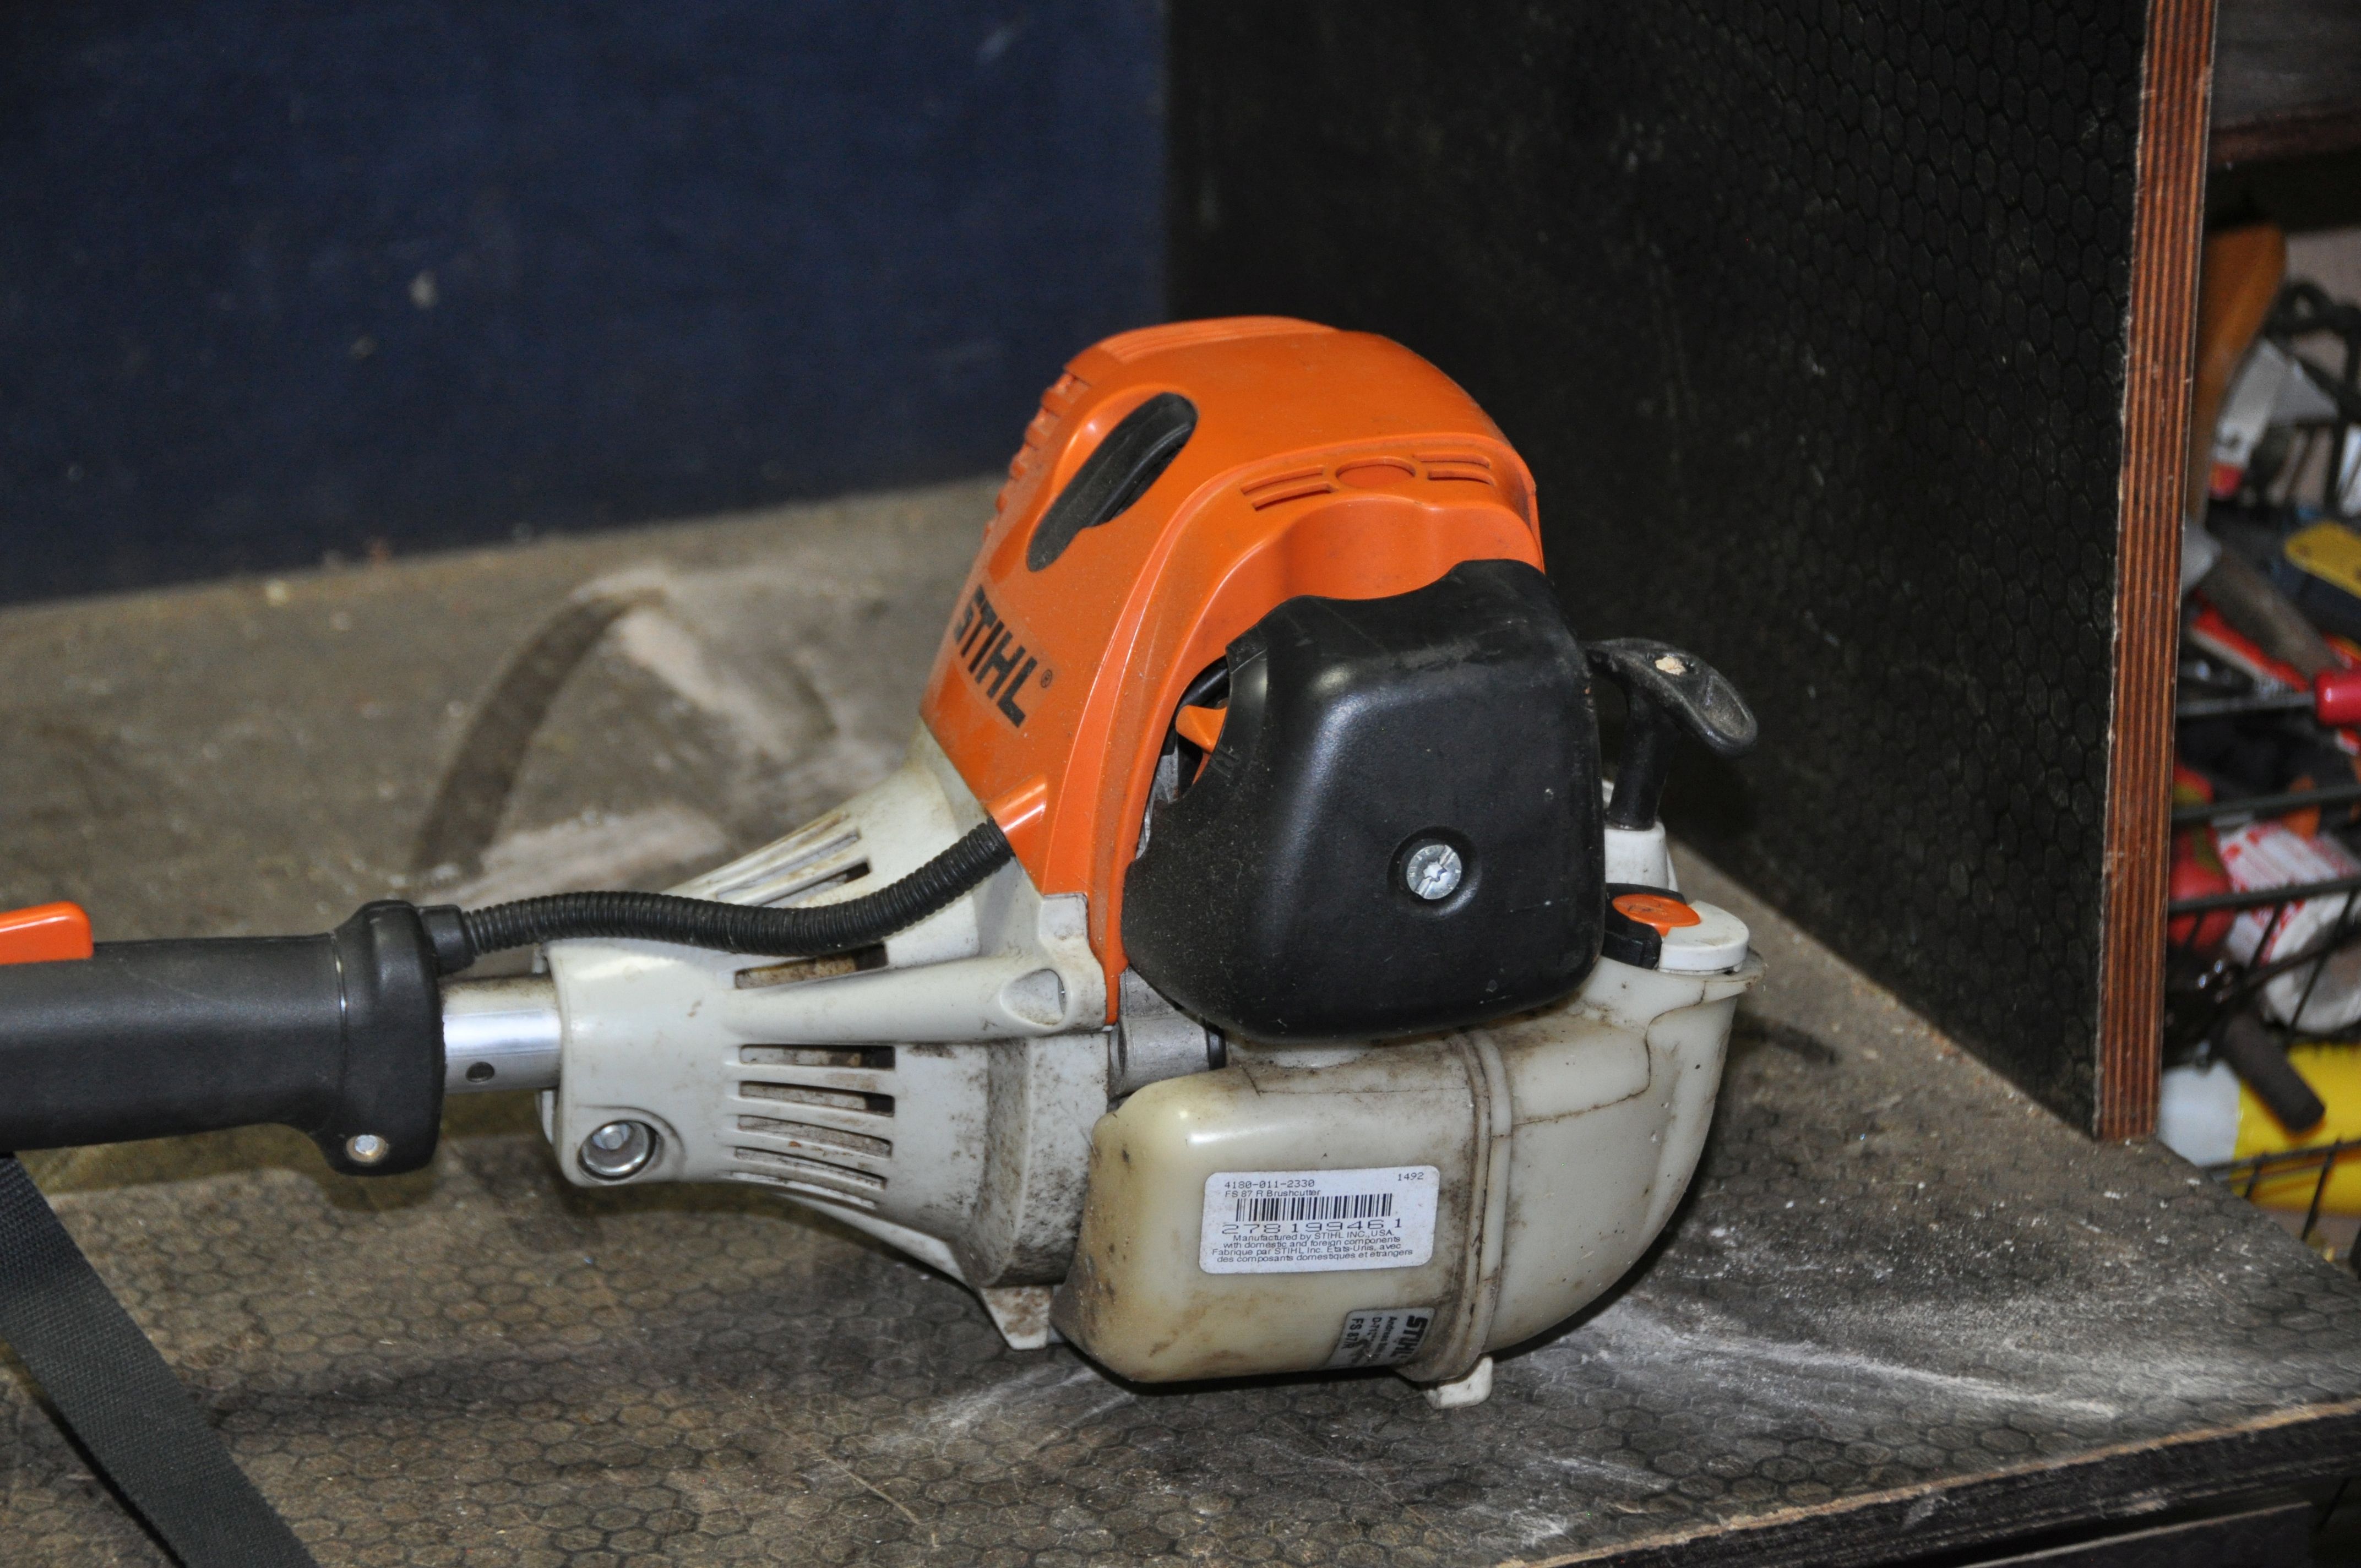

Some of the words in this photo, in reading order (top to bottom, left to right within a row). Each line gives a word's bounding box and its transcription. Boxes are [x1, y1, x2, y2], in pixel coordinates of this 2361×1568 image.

[954, 584, 1038, 728] STIHL
[1397, 1172, 1424, 1181] 1492
[1224, 1179, 1315, 1189] 4180-011-2330
[1222, 1218, 1402, 1234] 278199461
[1233, 1233, 1297, 1242] Manufactured
[1300, 1233, 1312, 1242] by
[1344, 1237, 1401, 1245] components
[1212, 1248, 1253, 1256] Fabrique
[1296, 1253, 1355, 1261] domestiques
[1350, 1318, 1364, 1330] FS
[1390, 1315, 1428, 1357] STIHL
